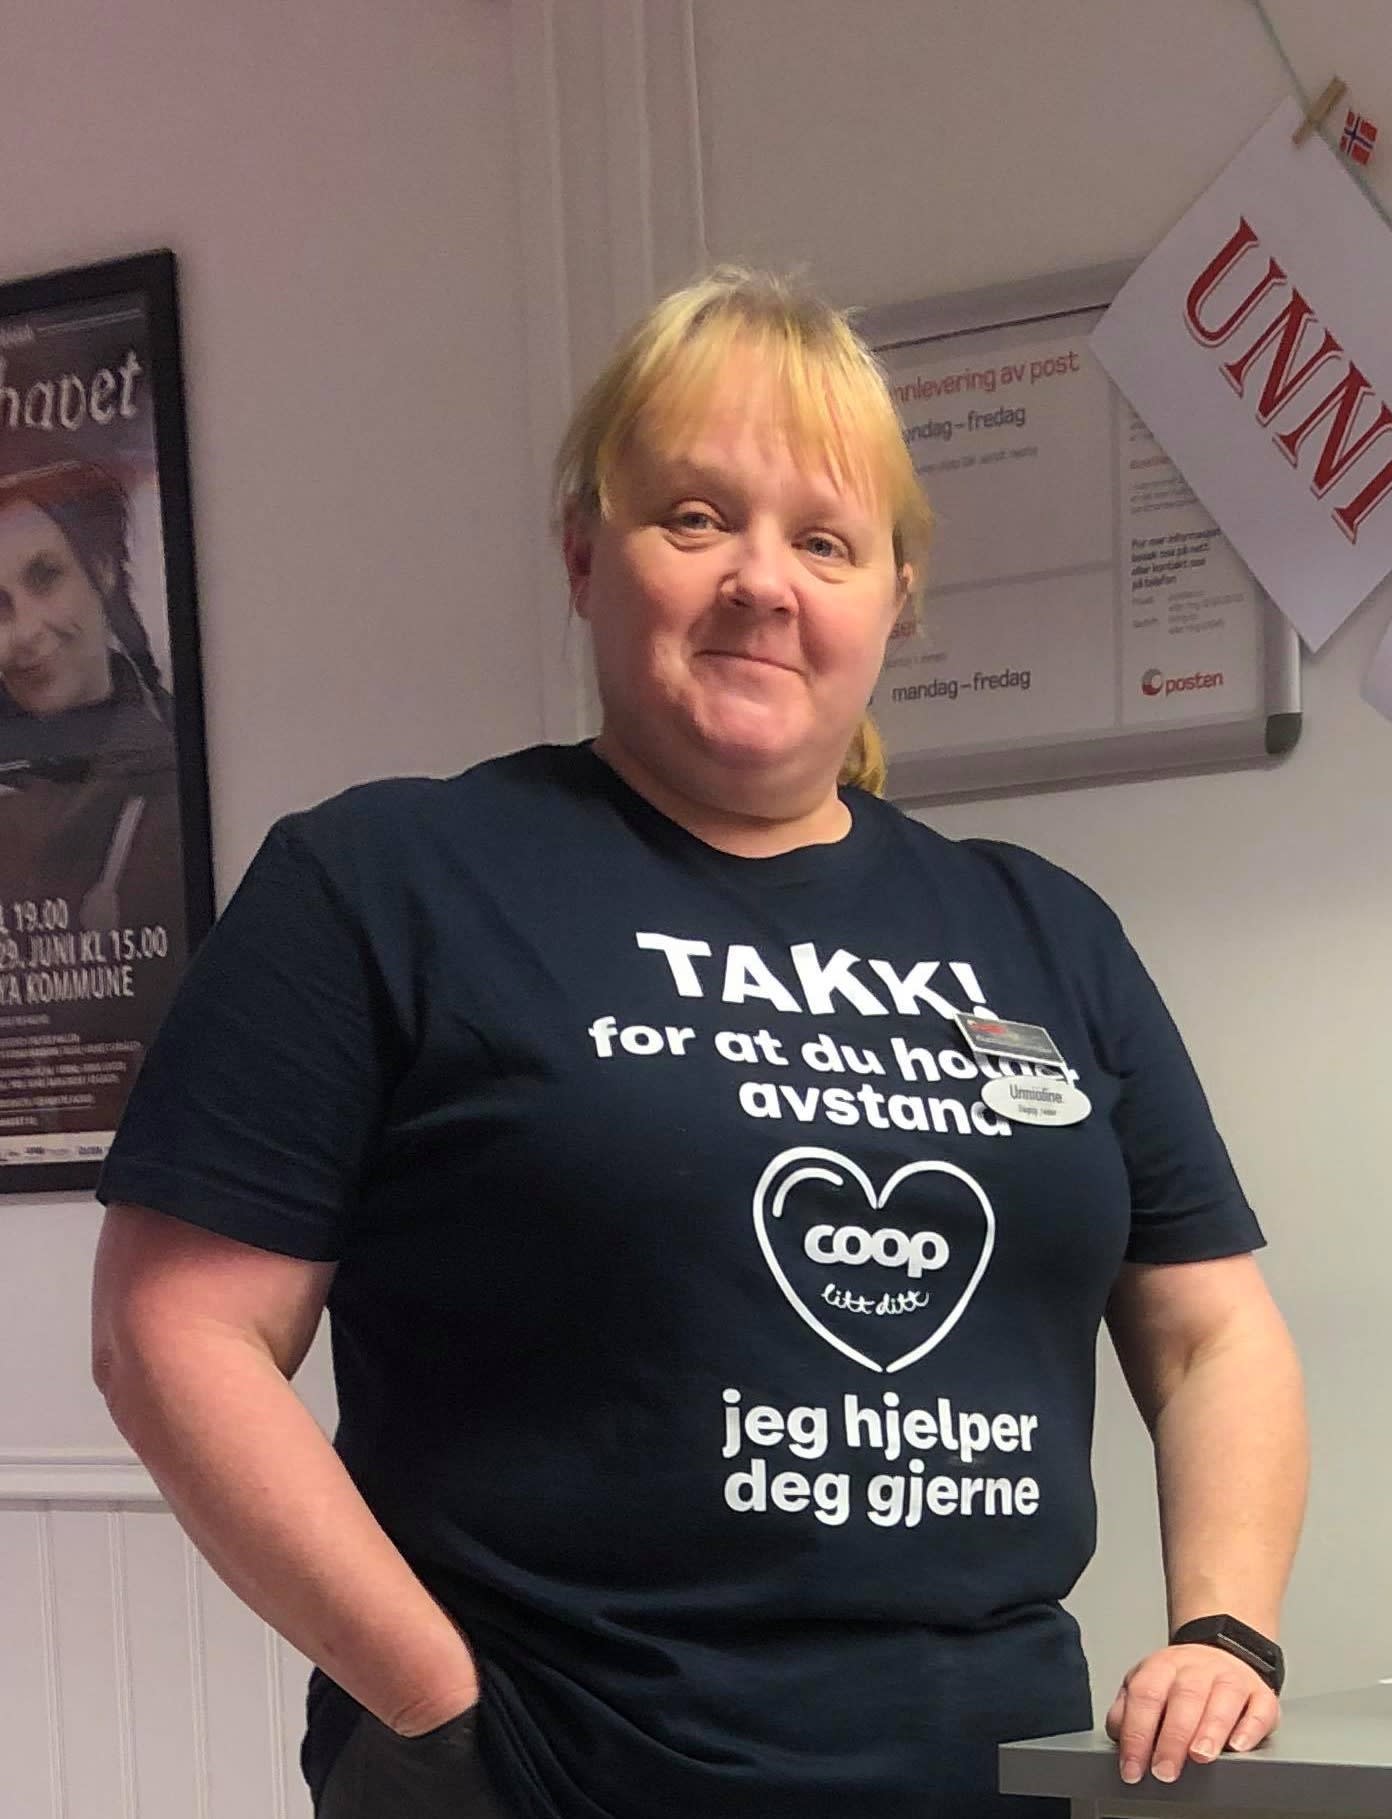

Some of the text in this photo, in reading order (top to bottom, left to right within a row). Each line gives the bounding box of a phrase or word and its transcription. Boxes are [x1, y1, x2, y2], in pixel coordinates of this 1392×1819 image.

[891, 351, 1081, 404] nnlevering av post
[1164, 669, 1225, 698] posten
[29, 931, 76, 968] JUNI
[80, 929, 107, 964] KL
[109, 925, 168, 962] 15.00
[26, 965, 135, 1004] KOMMUNE
[636, 931, 1000, 1022] TAKK!
[588, 1015, 697, 1058] for
[714, 1029, 790, 1066] at
[800, 1033, 887, 1077] du
[804, 1224, 950, 1279] coop
[820, 1283, 931, 1316] litt ditt
[722, 1388, 1039, 1464] jeg hjelper
[723, 1457, 1040, 1528] deg gjerne
